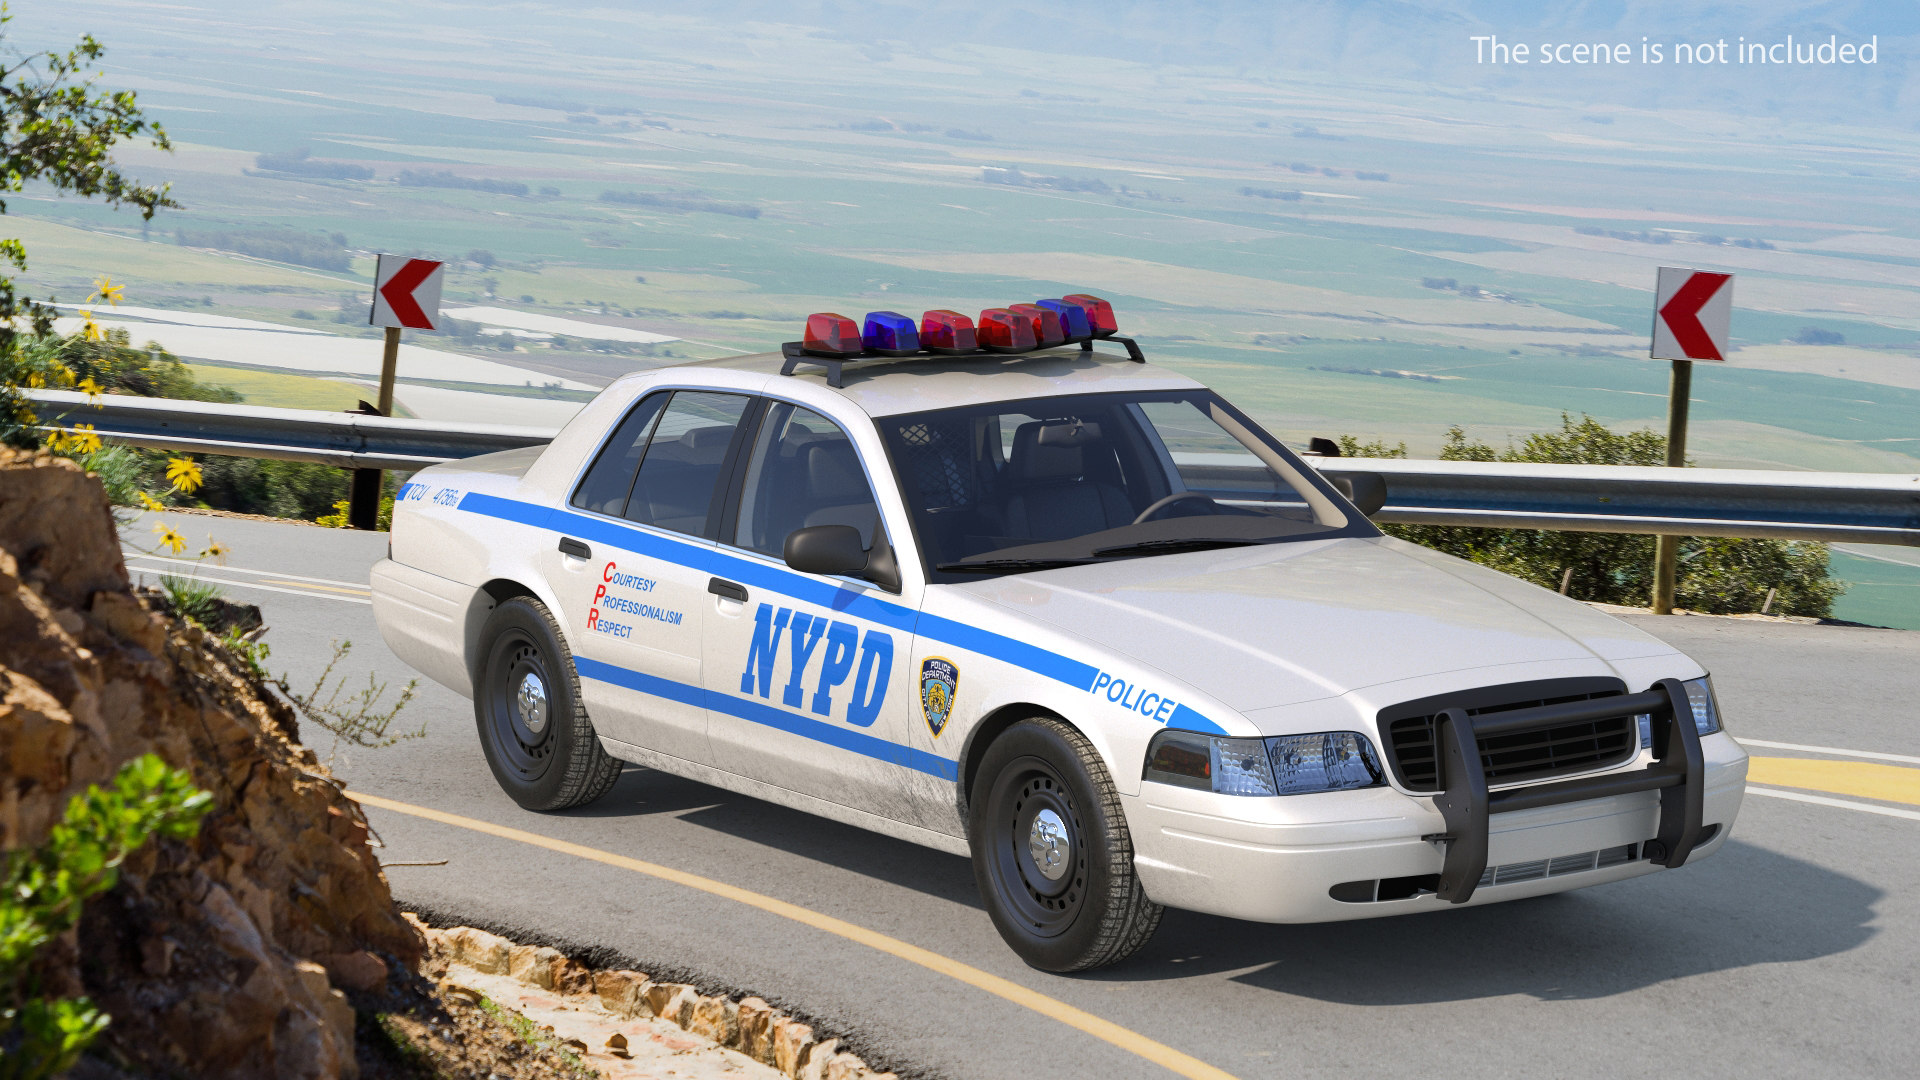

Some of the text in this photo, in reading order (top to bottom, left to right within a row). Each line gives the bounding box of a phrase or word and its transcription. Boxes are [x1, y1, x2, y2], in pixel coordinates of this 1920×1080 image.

[740, 602, 894, 728] NYPD
[922, 670, 955, 689] DEPARTMENT
[930, 661, 951, 674] POLICE
[1091, 671, 1176, 724] POLICE
